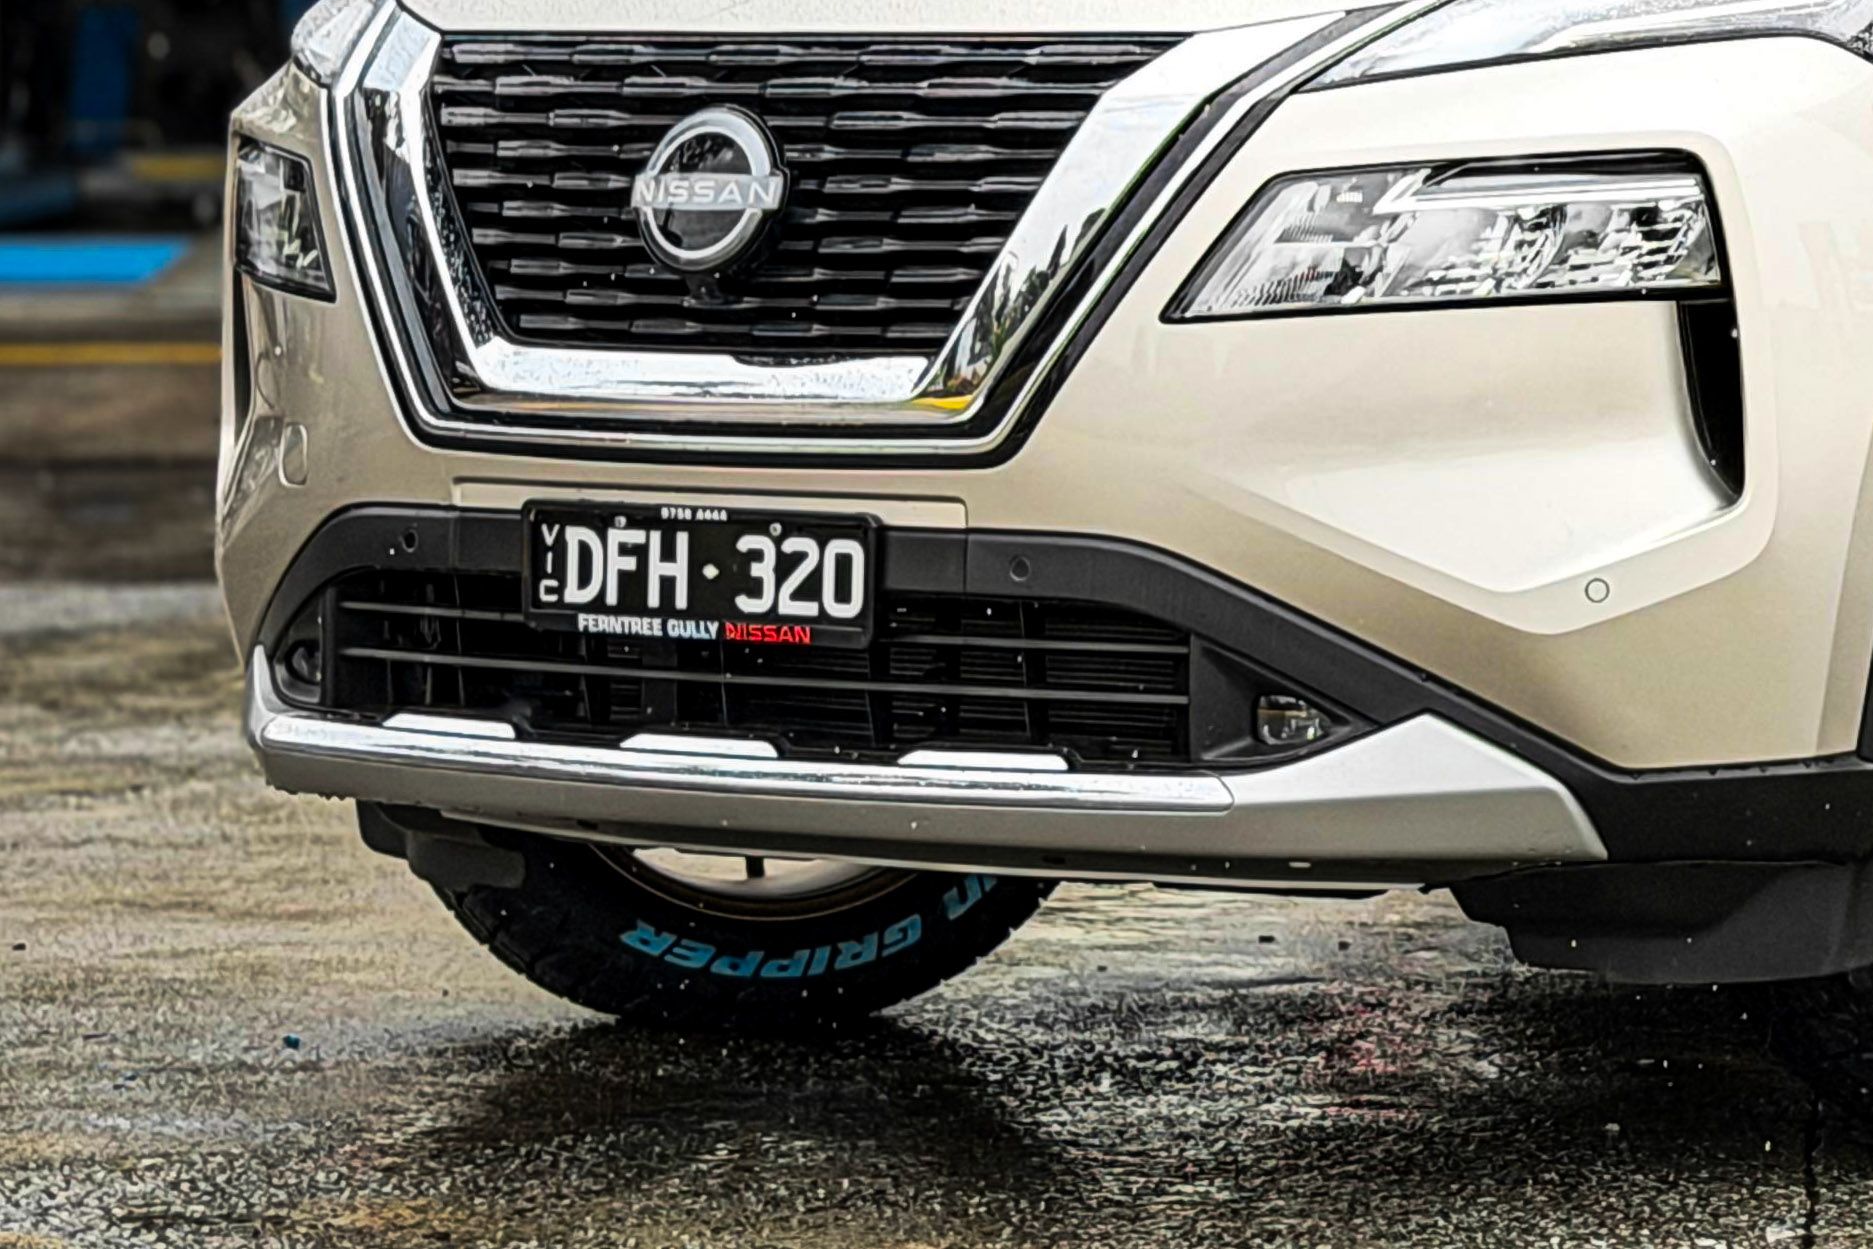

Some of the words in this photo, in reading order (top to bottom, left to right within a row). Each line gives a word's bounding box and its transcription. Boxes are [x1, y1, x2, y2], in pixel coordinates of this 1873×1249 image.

[635, 179, 777, 204] NISSAN
[539, 523, 560, 602] VIC
[577, 612, 663, 637] FERNTREE
[666, 618, 719, 640] GULLY
[725, 621, 811, 644] NISSAN
[620, 914, 922, 979] GRIPPER
